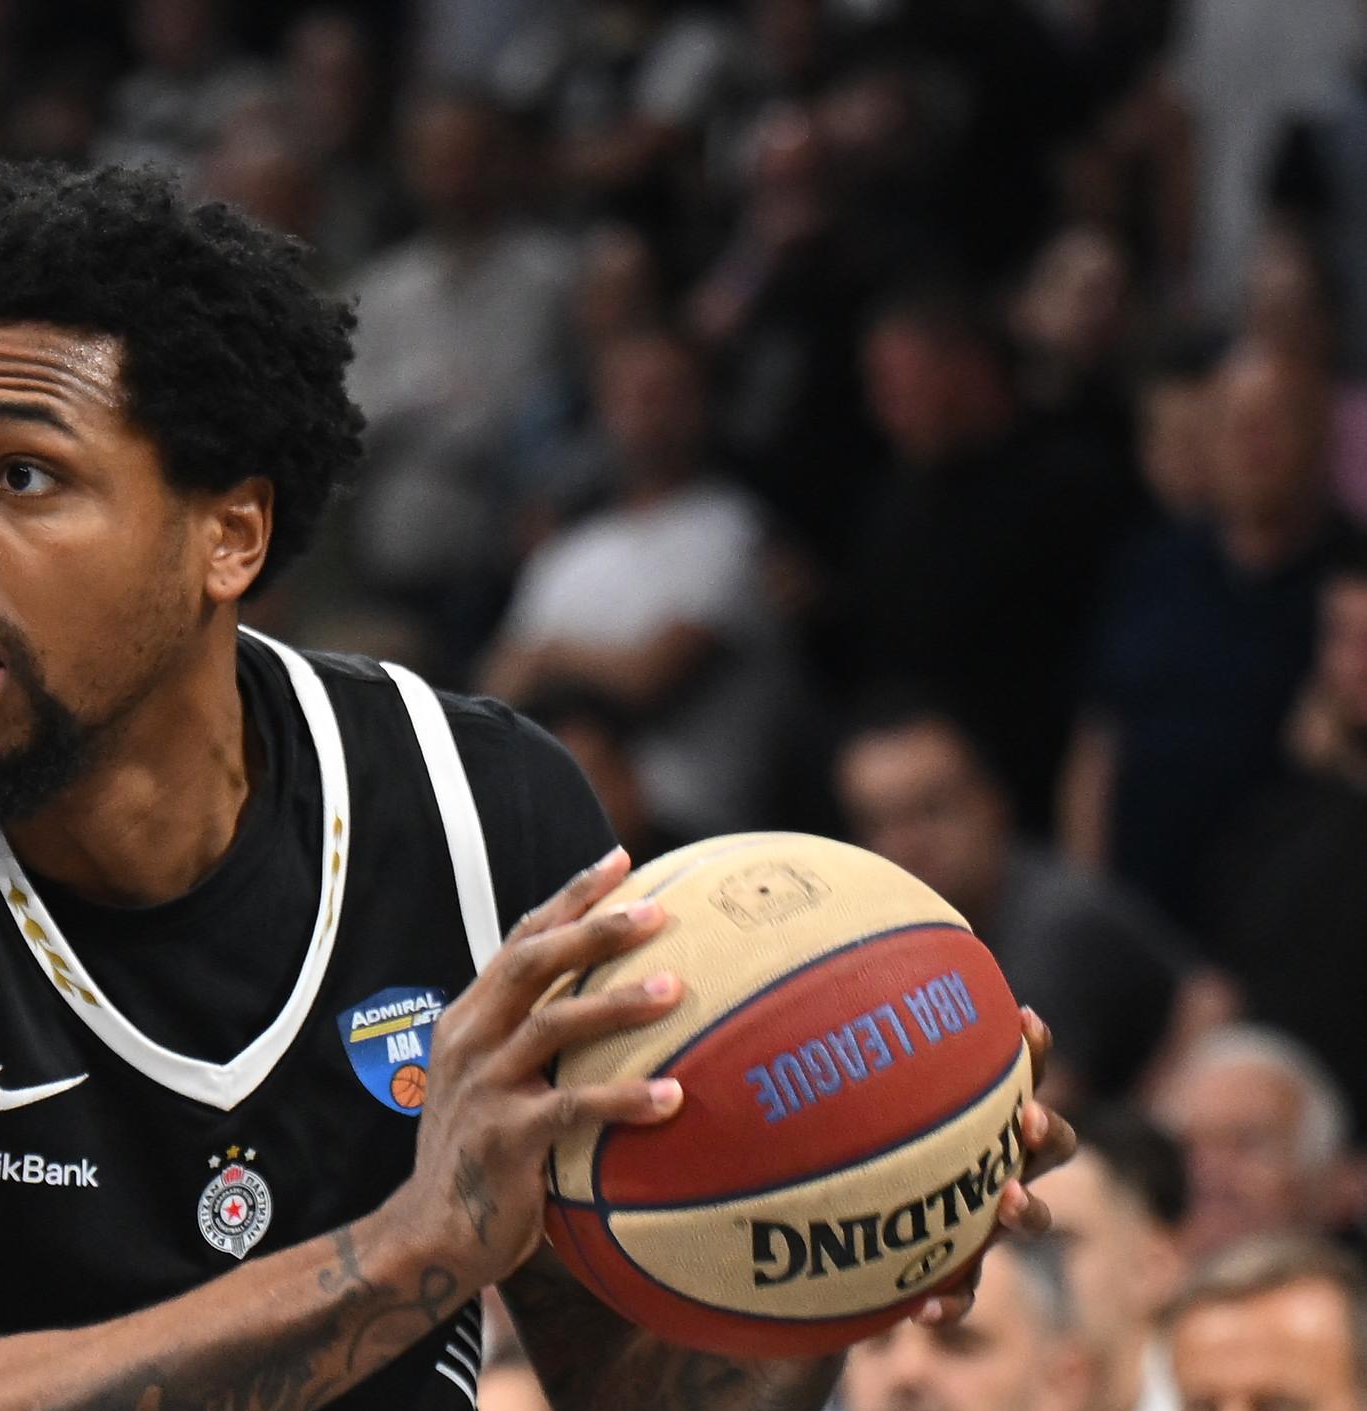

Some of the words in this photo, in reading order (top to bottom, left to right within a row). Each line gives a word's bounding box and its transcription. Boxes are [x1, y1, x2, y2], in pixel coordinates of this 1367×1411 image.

[352, 992, 441, 1029] ADMIRAL
[903, 970, 979, 1045] ABA
[387, 1030, 423, 1063] ABA
[744, 1003, 915, 1125] LEAGUE
